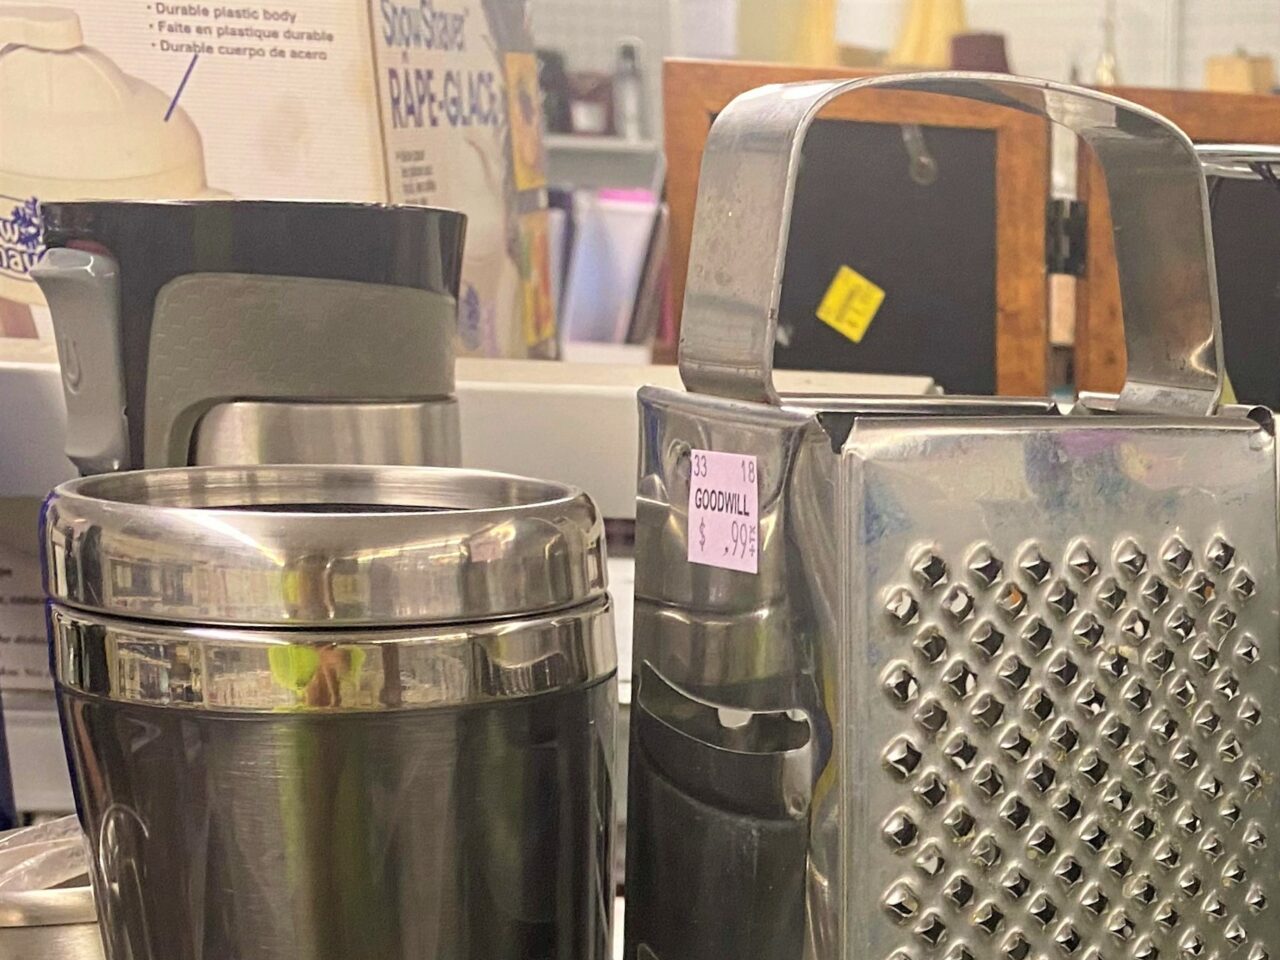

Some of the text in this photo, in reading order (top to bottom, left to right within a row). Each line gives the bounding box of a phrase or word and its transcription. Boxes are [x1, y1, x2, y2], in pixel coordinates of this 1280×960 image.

[156, 2, 298, 24] Durable plastic body
[195, 25, 212, 35] en
[216, 26, 279, 42] plastique
[283, 29, 335, 42] durable
[160, 39, 328, 61] Durable cuerpo de acero
[694, 454, 756, 484] 33 18
[694, 487, 750, 517] GOODWILL
